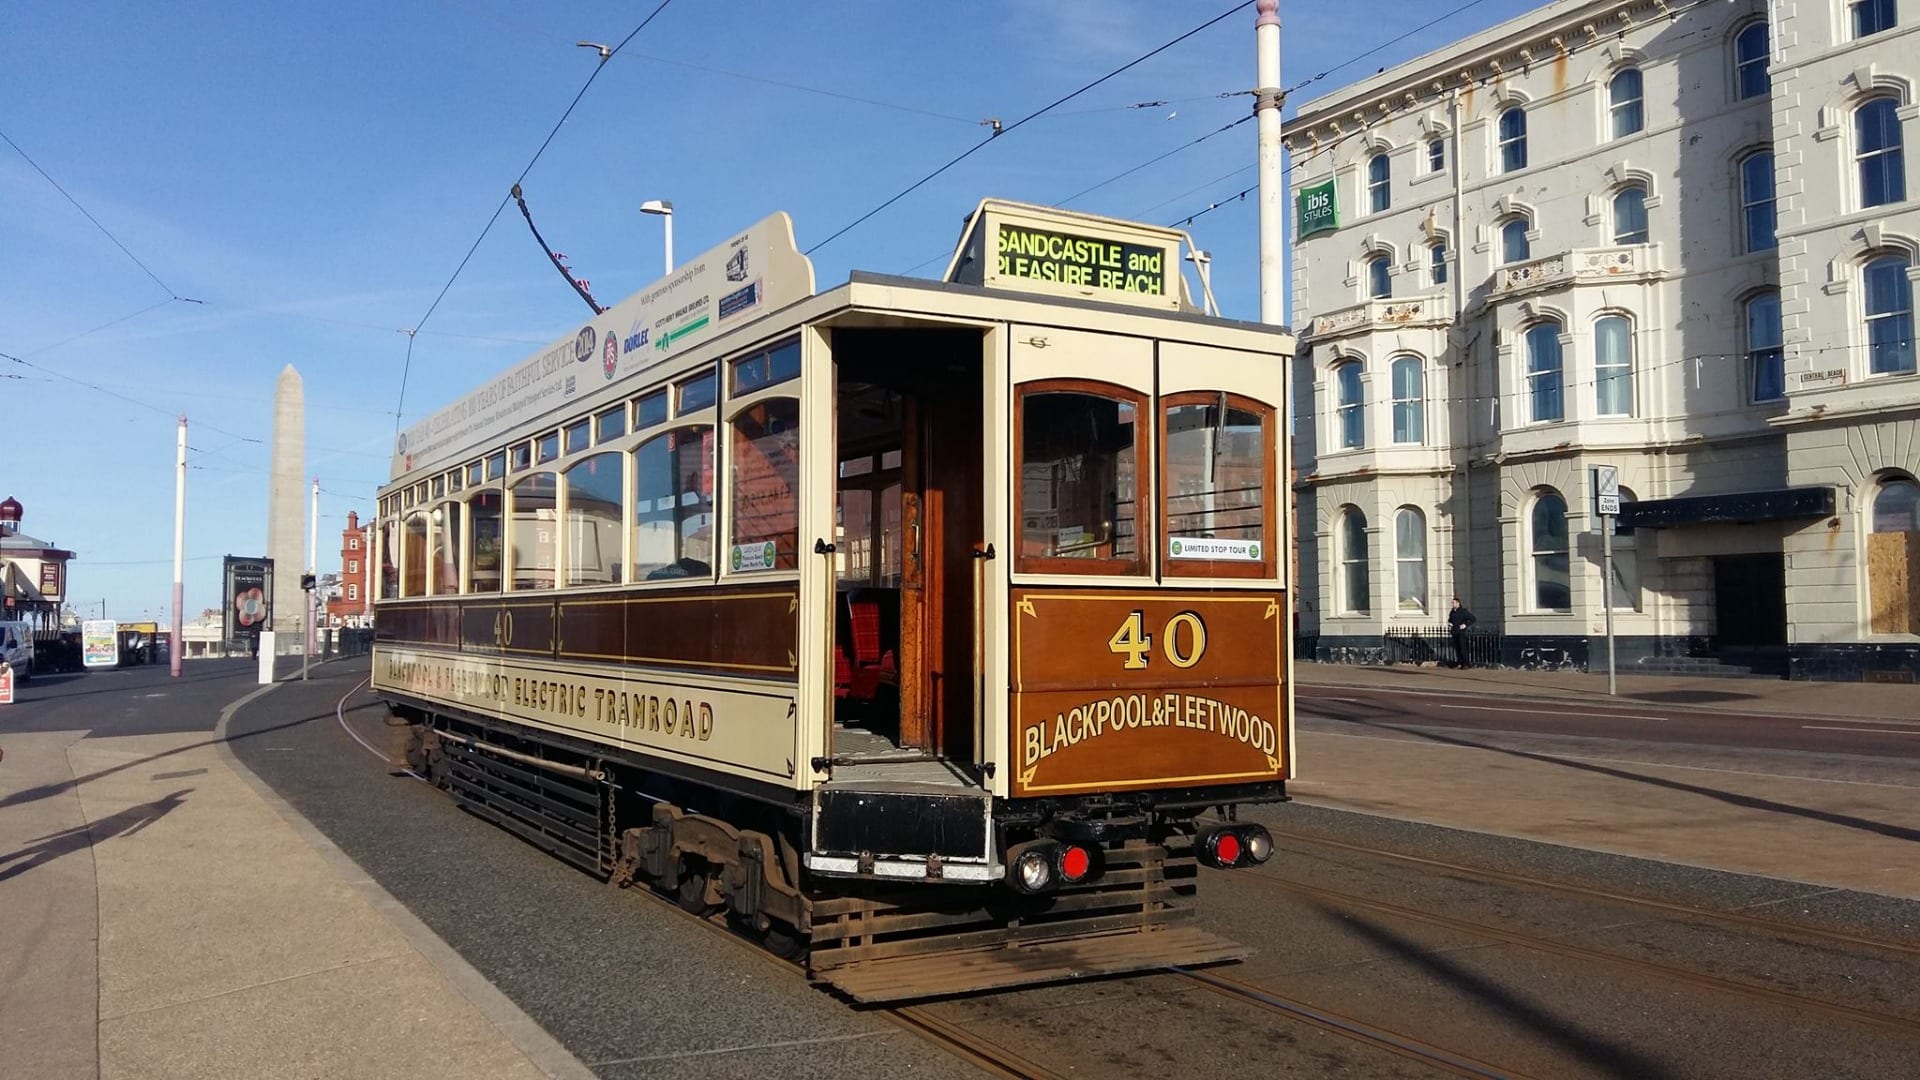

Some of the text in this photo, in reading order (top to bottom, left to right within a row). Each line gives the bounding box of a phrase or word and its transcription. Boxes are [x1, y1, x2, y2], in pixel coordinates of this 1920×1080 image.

[1307, 191, 1329, 211] ibis
[999, 229, 1160, 274] SANDCASTLE and
[1099, 269, 1161, 296] BEACH
[1601, 504, 1618, 512] ENDS
[1184, 544, 1247, 554] LIMITED STOP TOUR
[493, 609, 513, 647] 40
[1108, 611, 1207, 669] 40
[515, 677, 586, 718] ELECTRIC
[595, 688, 714, 742] TRAMROAD
